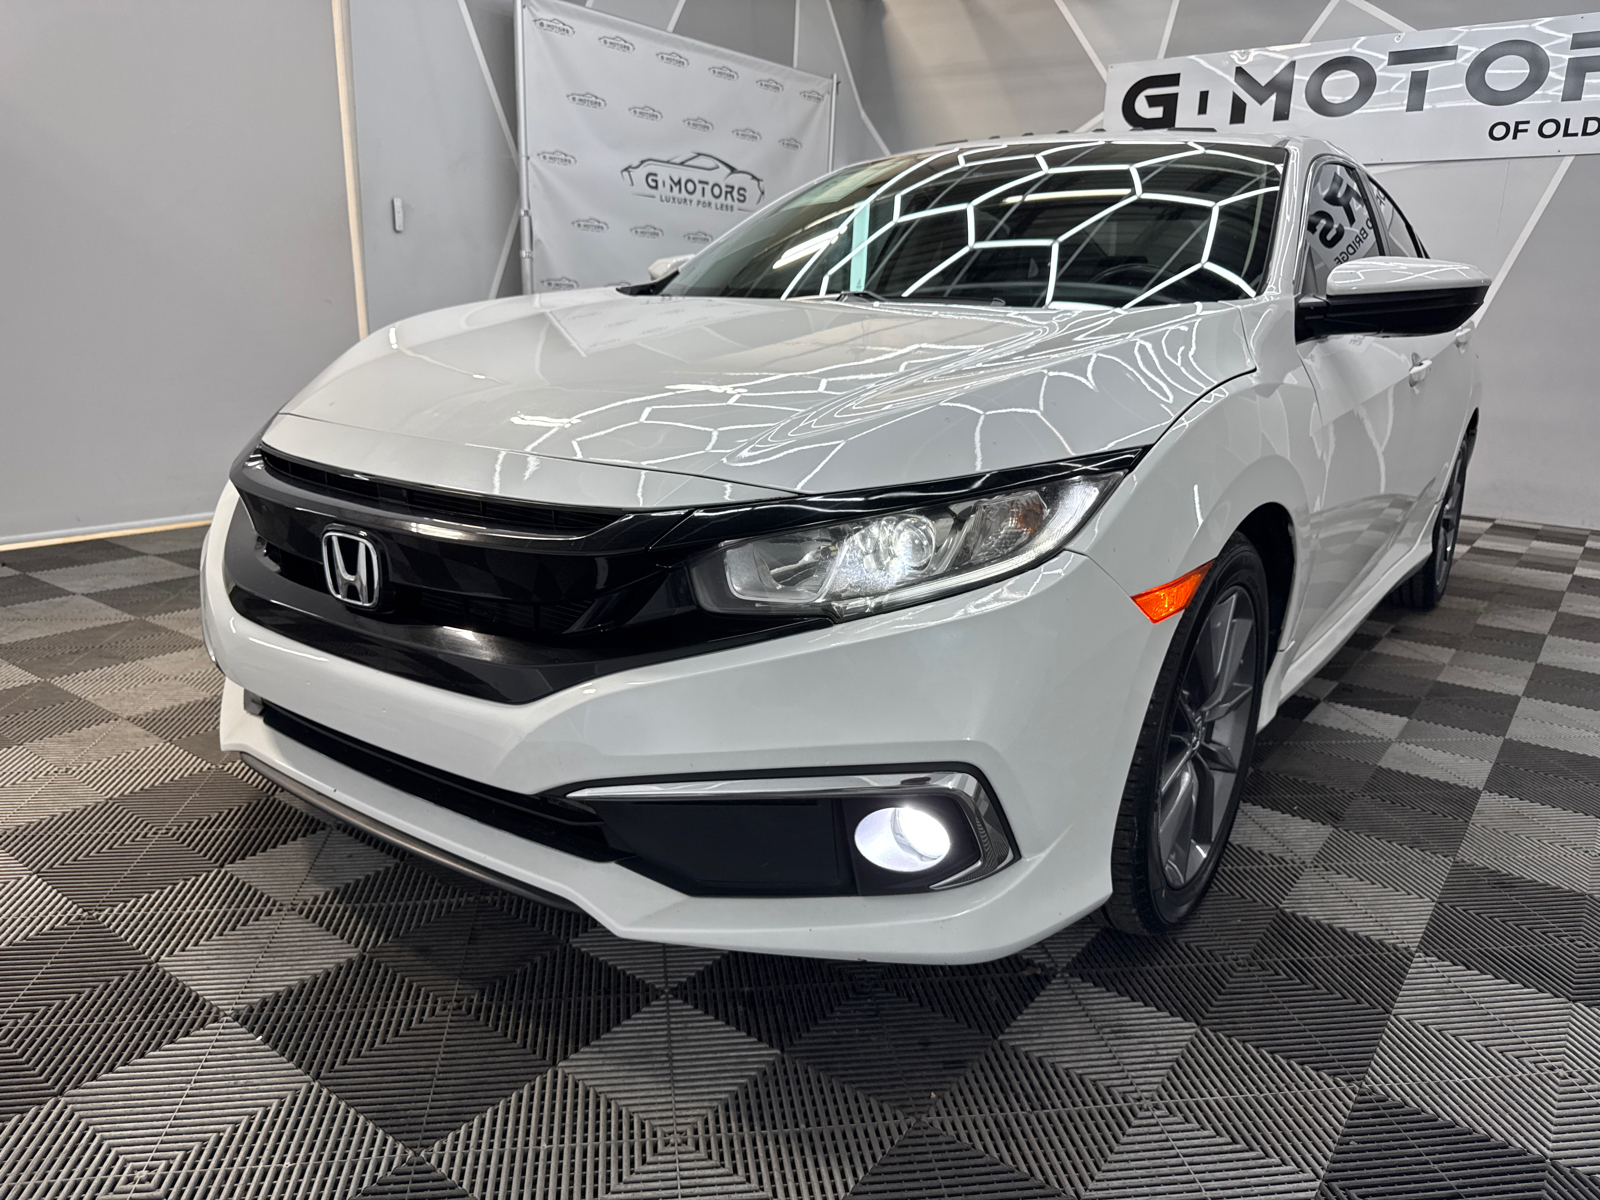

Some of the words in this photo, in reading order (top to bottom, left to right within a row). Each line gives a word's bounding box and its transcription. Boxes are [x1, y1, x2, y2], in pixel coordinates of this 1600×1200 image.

[1488, 120, 1531, 141] OF
[1537, 116, 1600, 139] OLD
[660, 194, 693, 207] LUXURY
[696, 200, 713, 210] FOR
[715, 203, 735, 213] LESS
